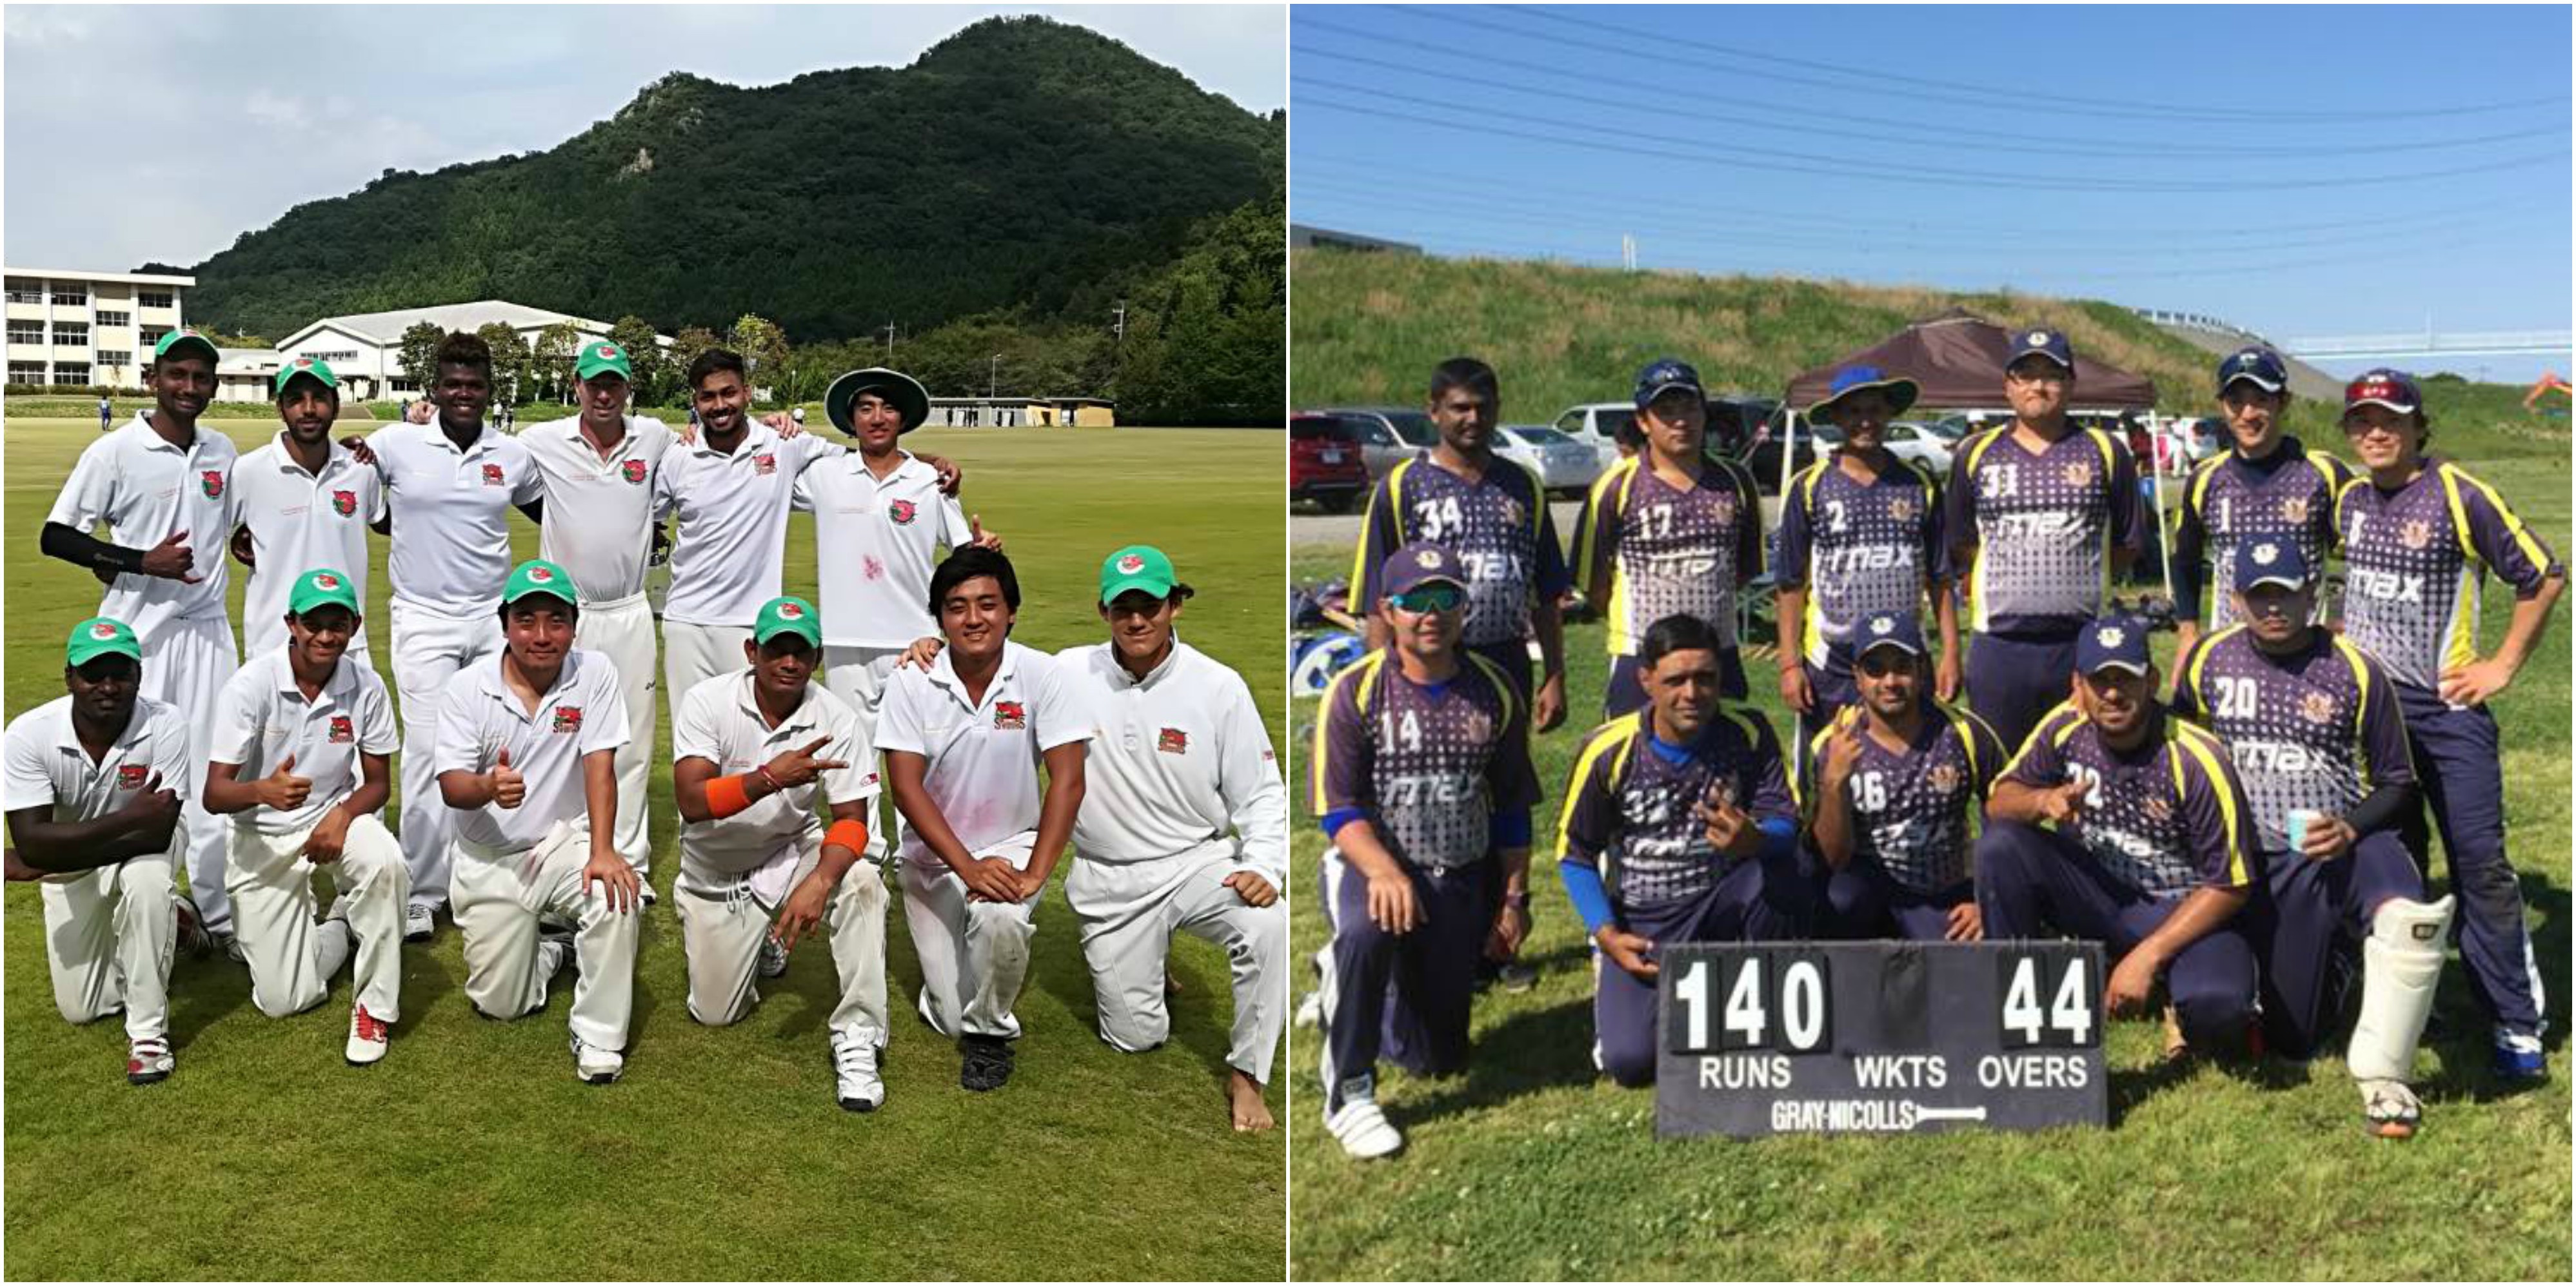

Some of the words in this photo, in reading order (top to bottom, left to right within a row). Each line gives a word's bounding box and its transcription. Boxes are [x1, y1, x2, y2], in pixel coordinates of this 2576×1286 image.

[1981, 464, 2018, 498] 31
[1414, 496, 1463, 540] 34
[1637, 503, 1672, 540] 17
[1826, 500, 1848, 532] 2
[2214, 676, 2257, 720] 20
[1380, 709, 1422, 755] 14
[1676, 958, 1824, 1049] 140
[2003, 956, 2092, 1044] 44
[1699, 1056, 1792, 1089] RUNS
[1854, 1056, 1948, 1088] WKTS
[1977, 1055, 2088, 1089] OVERS
[1772, 1100, 1916, 1131] GRAY-NICOLLS
